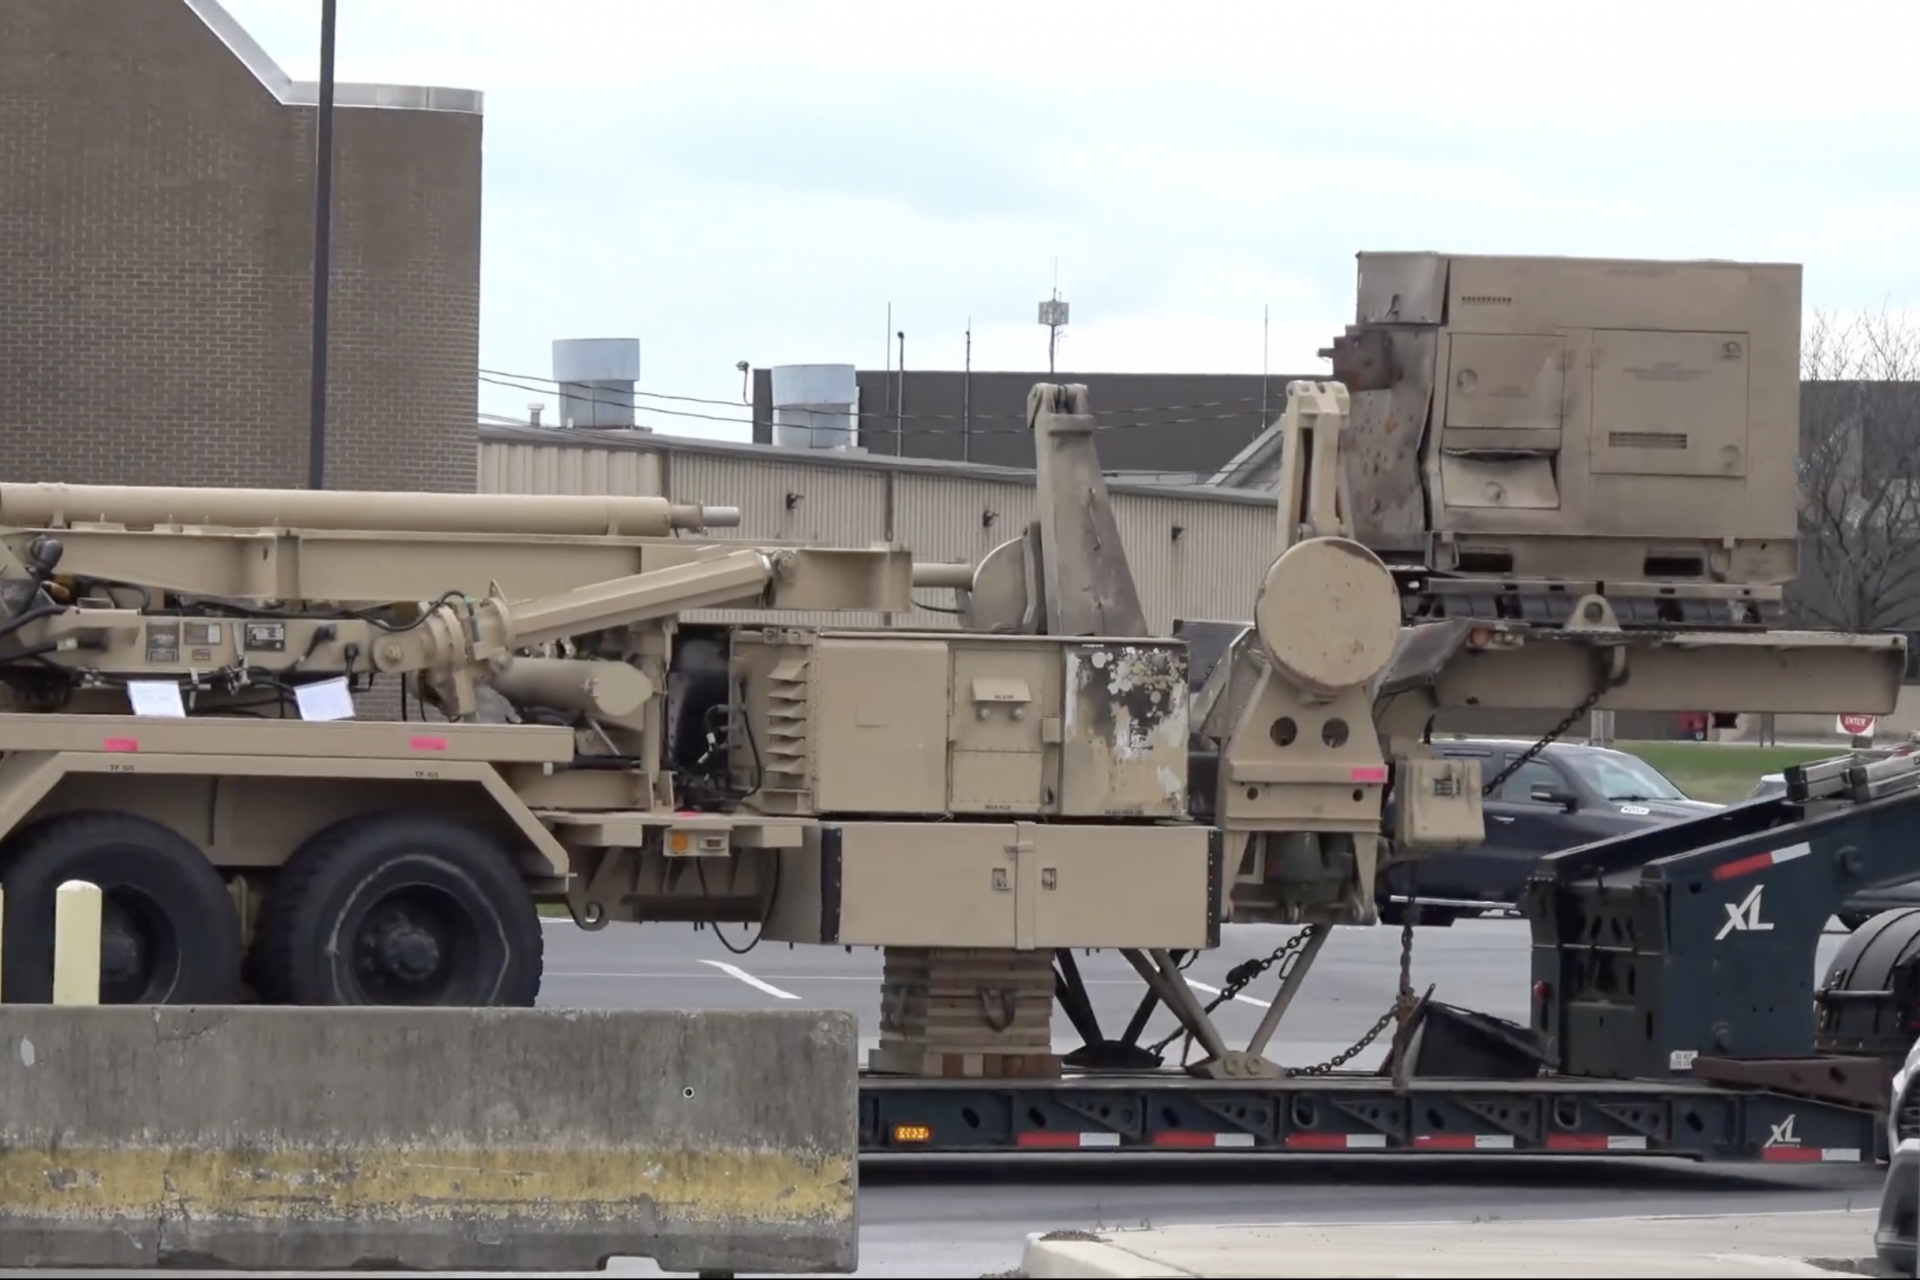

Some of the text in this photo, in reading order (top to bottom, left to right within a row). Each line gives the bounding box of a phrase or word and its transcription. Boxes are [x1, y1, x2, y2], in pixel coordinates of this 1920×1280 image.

[1845, 716, 1867, 727] ENTER
[1714, 884, 1774, 940] XL
[1763, 1114, 1802, 1148] XL
